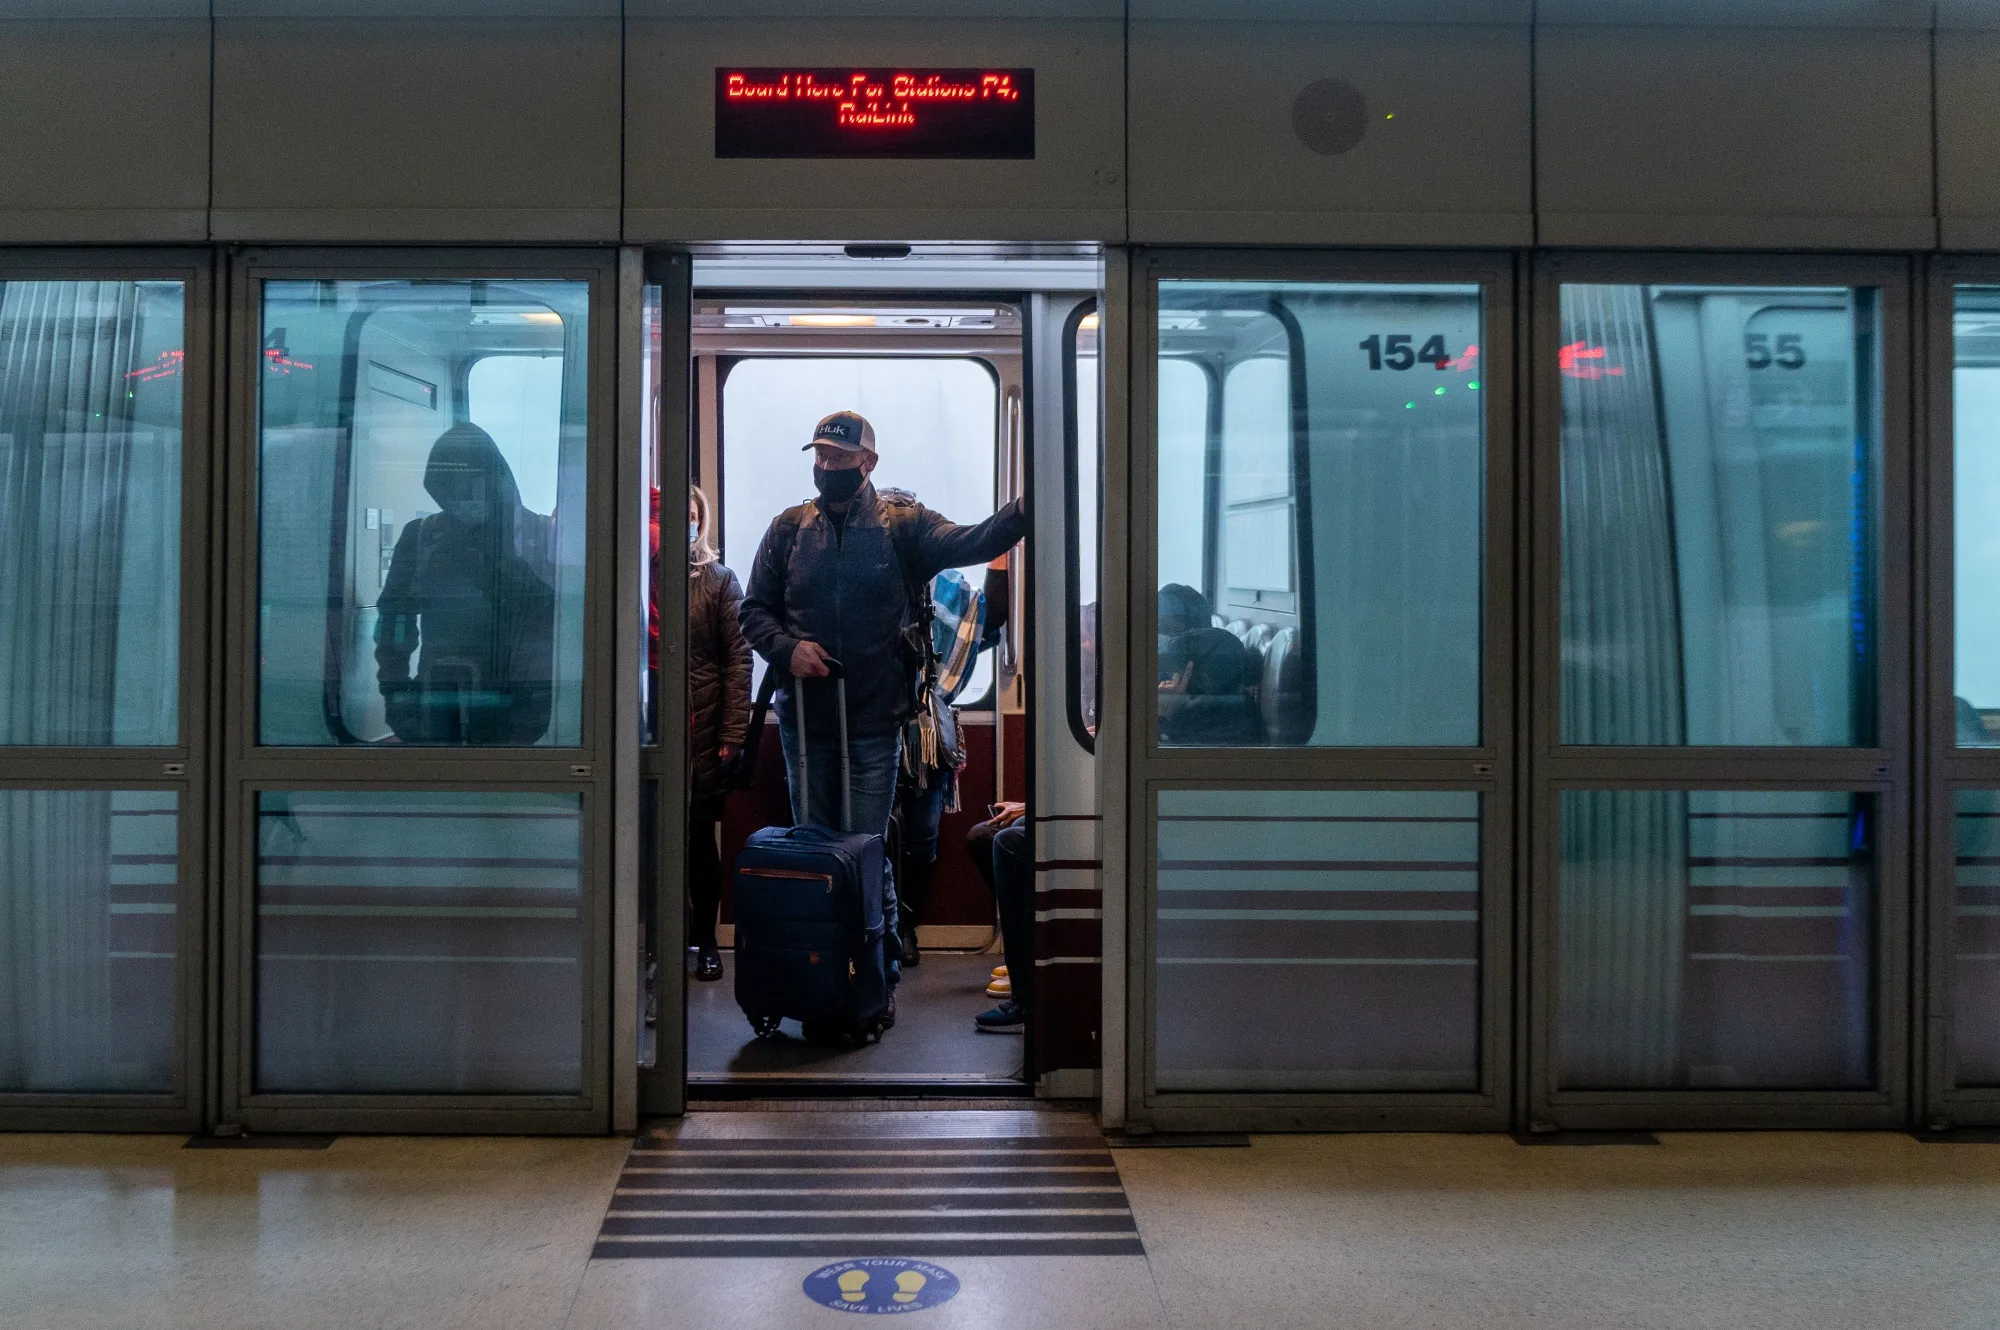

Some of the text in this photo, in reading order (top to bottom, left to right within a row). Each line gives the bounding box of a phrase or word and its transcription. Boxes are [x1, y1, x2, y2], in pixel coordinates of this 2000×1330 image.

[1358, 334, 1450, 371] 154
[860, 1259, 908, 1268] YOUR
[829, 1300, 924, 1313] SAVE LIVES
